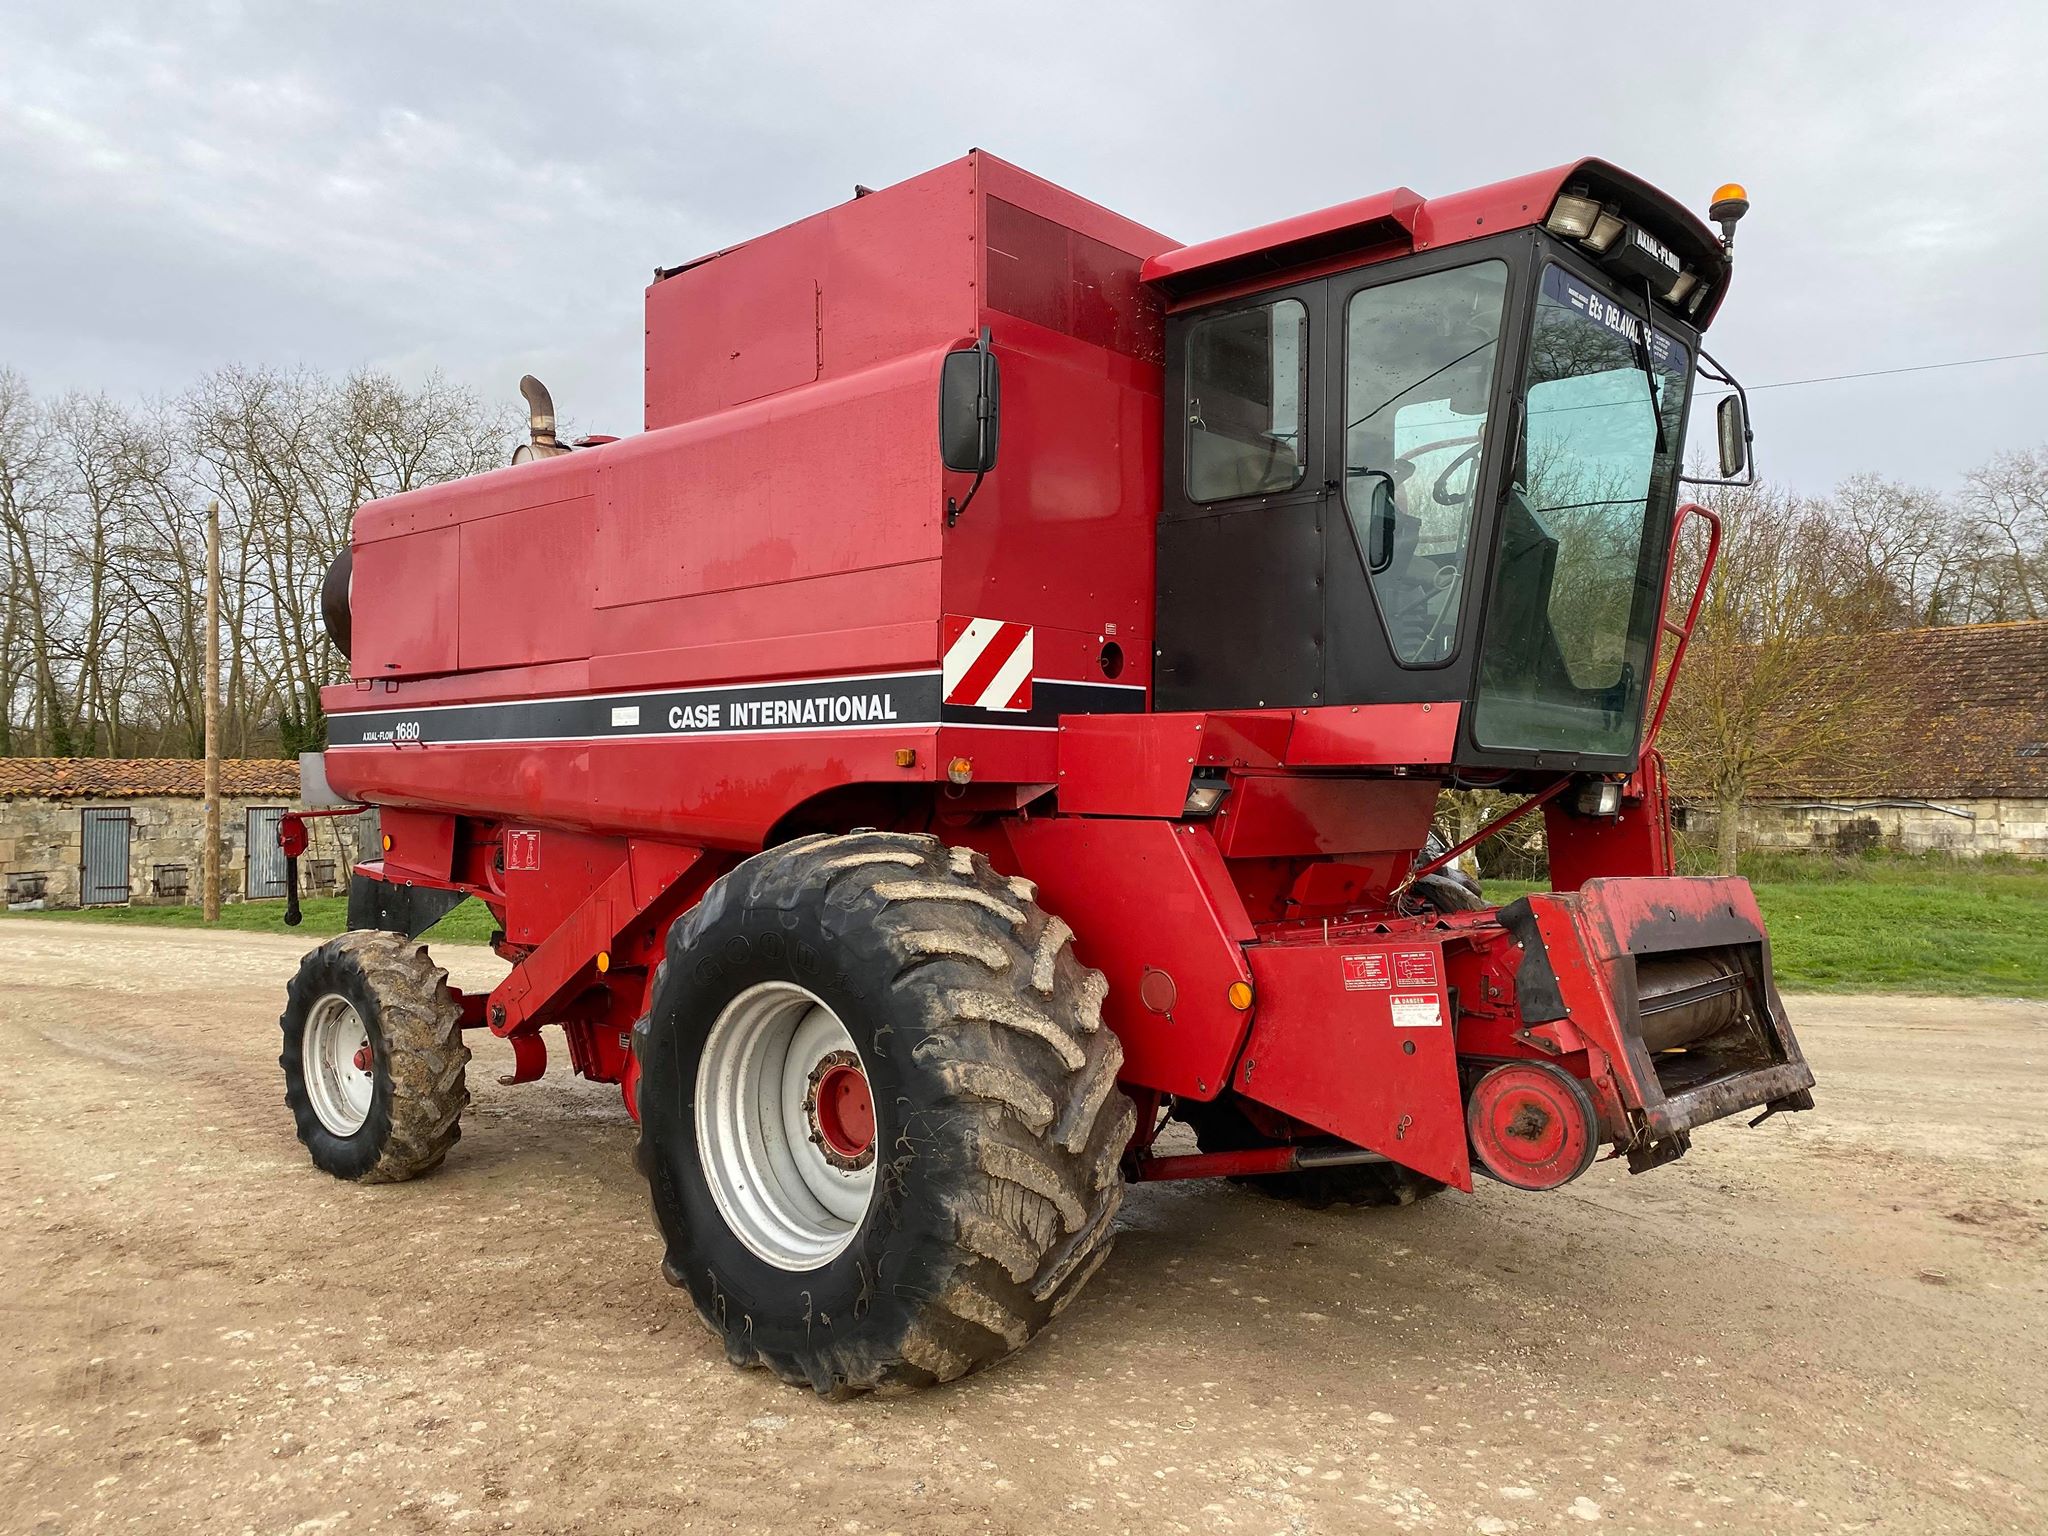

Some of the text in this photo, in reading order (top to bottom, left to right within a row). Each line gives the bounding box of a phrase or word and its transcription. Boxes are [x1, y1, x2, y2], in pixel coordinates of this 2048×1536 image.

[1588, 294, 1604, 321] Ets
[668, 704, 720, 729] CASE
[729, 693, 898, 727] INTERNATIONAL
[396, 722, 420, 740] 1680
